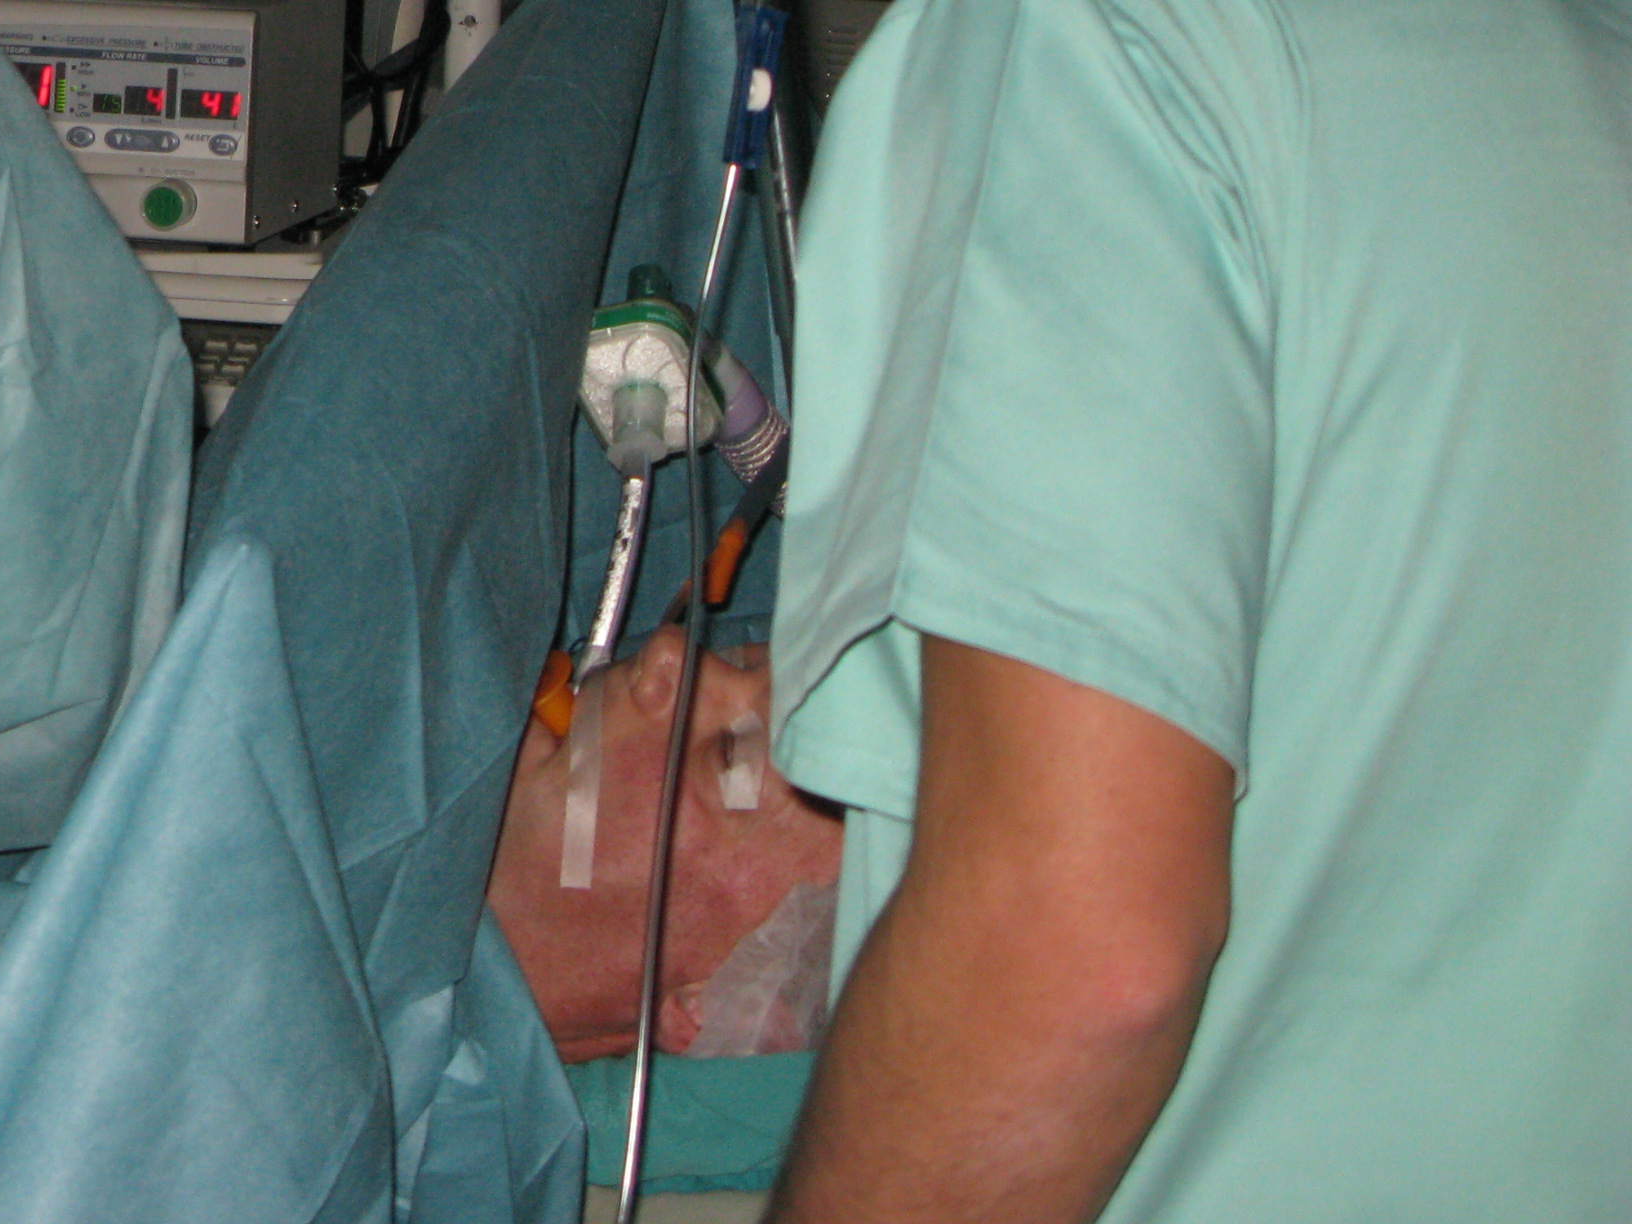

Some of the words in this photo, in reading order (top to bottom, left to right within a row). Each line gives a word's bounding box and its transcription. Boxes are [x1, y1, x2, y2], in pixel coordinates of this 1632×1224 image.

[195, 56, 229, 65] VOLUME
[146, 87, 165, 112] 4
[201, 91, 242, 117] 41
[184, 133, 211, 142] RESET
